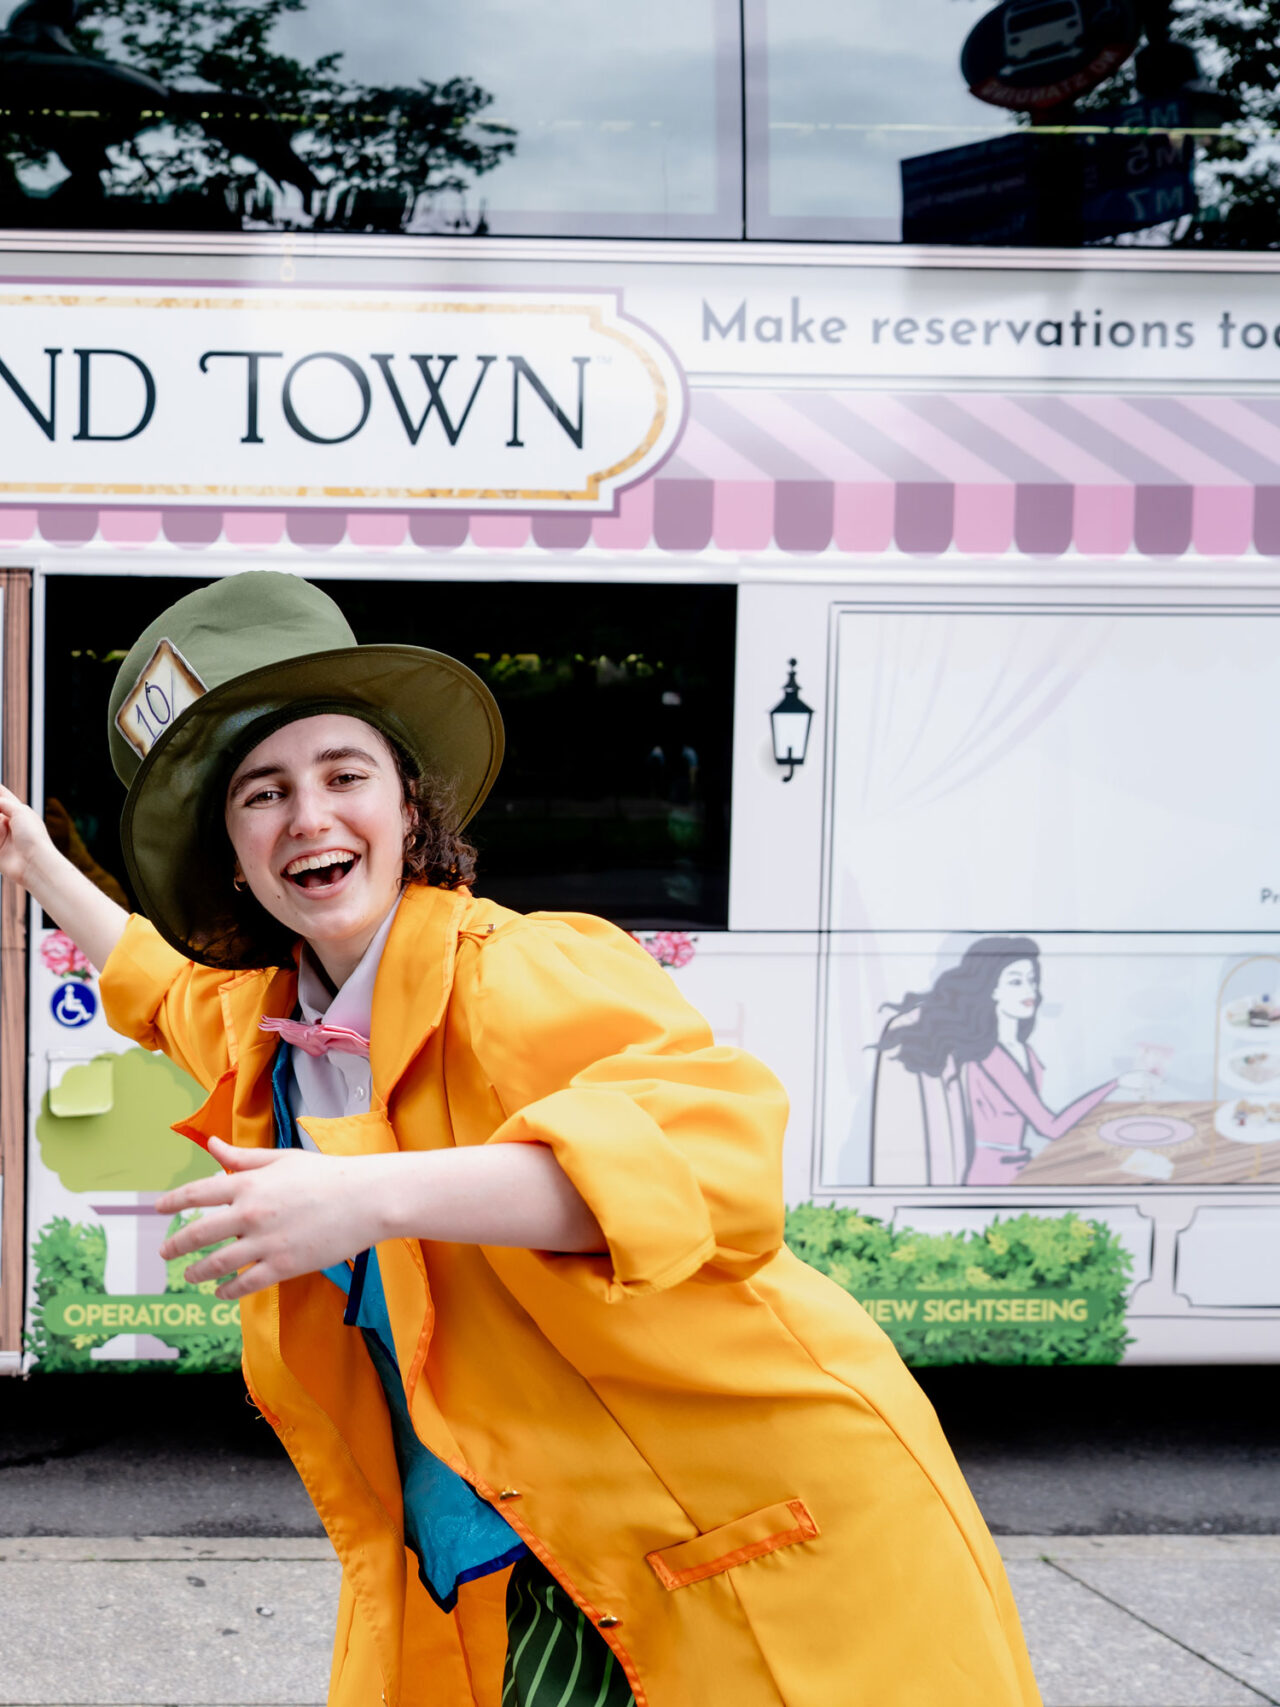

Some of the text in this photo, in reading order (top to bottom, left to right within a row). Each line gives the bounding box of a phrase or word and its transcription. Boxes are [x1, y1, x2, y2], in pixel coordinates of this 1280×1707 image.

[702, 296, 847, 344] Make
[872, 308, 1195, 350] reservations
[199, 351, 592, 450] TOWN
[63, 1303, 206, 1327] OPERATOR:
[923, 1298, 1089, 1323] SIGHTSEEING
